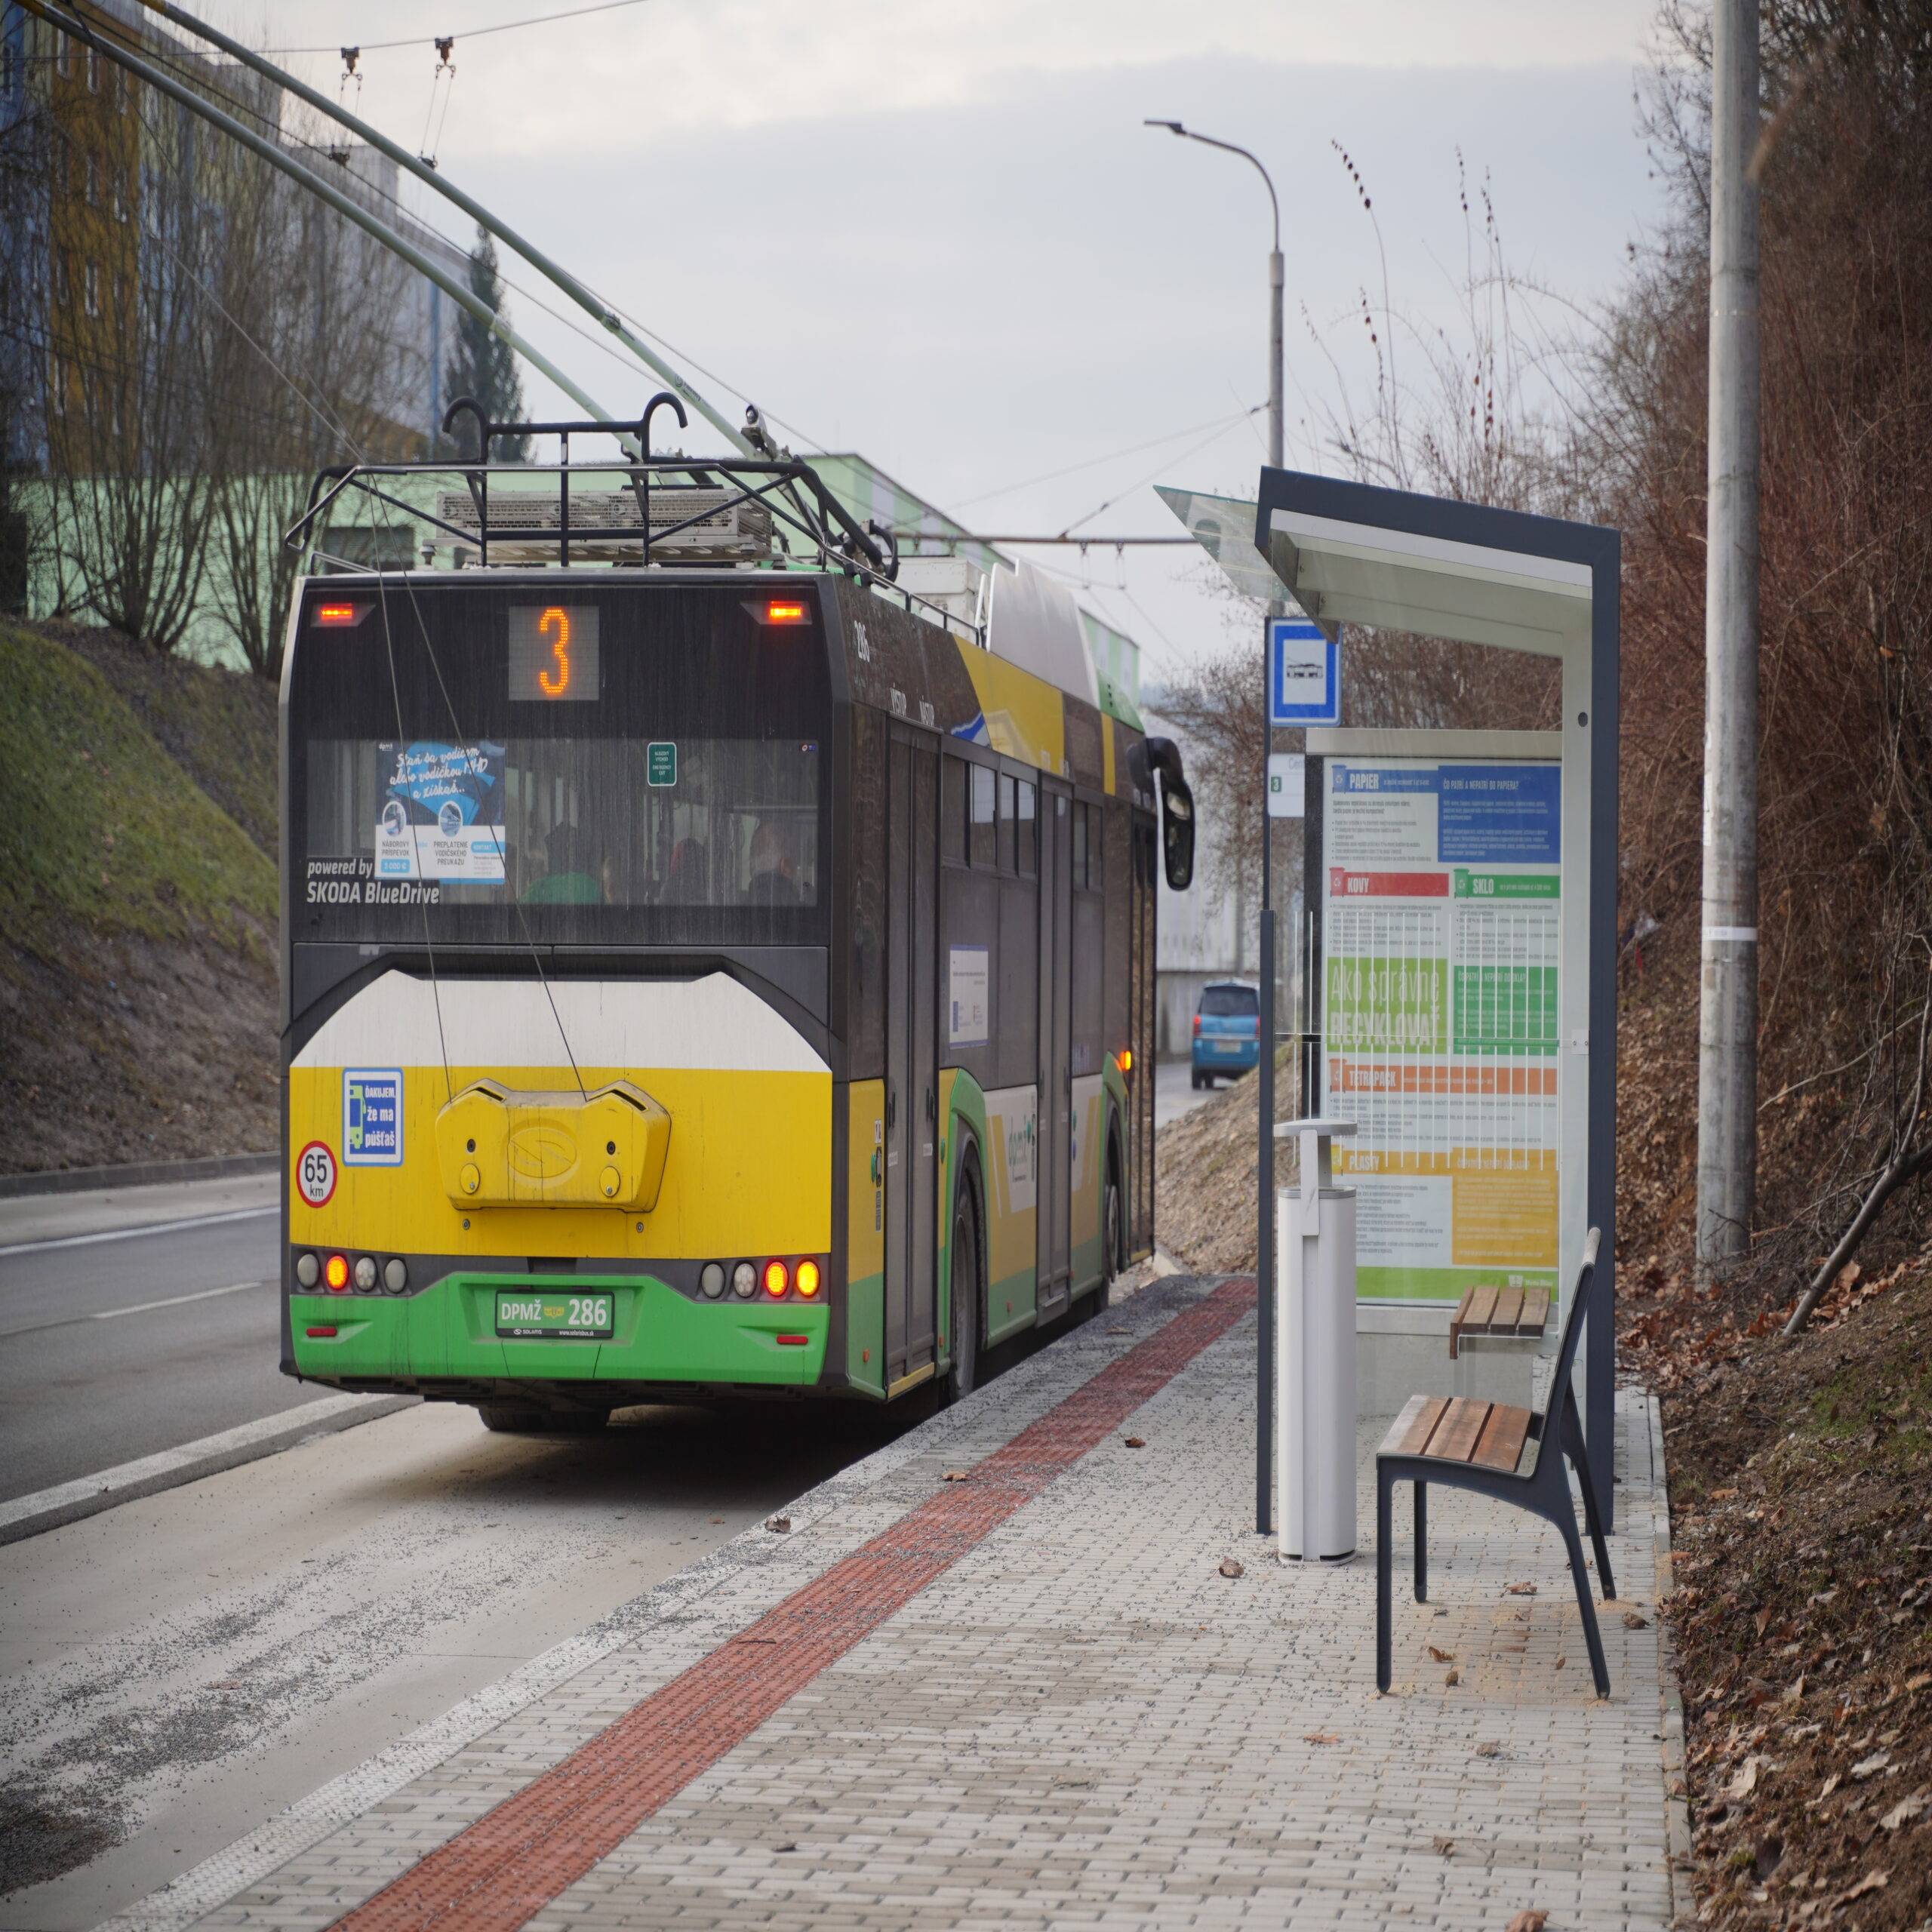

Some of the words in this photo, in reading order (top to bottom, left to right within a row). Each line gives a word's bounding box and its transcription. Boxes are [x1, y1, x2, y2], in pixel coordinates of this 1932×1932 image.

[854, 620, 870, 663] 286
[540, 608, 568, 694] 3
[424, 752, 438, 763] sa
[390, 768, 417, 785] alebo
[419, 762, 463, 782] vodičkou
[464, 757, 488, 774] MHD
[1273, 778, 1279, 791] 3
[1349, 773, 1380, 789] PAPIER
[307, 858, 356, 878] powered
[358, 858, 374, 878] by
[306, 881, 361, 903] SKODA
[365, 881, 439, 904] BlueDrive
[1347, 878, 1370, 895] KOVY
[1472, 878, 1494, 894] SKLO
[1331, 965, 1362, 1001] Ako
[1368, 965, 1439, 1006] správne
[1331, 1005, 1440, 1046] RECYKLOVAŤ
[1349, 1070, 1395, 1087] TETRAPACK
[367, 1106, 377, 1121] že
[380, 1109, 394, 1121] ma
[365, 1131, 395, 1148] púšťaš
[305, 1154, 327, 1183] 65
[1349, 1154, 1380, 1171] PLASTY
[310, 1184, 323, 1197] km
[501, 1299, 541, 1321] DPMŽ
[568, 1298, 607, 1326] 286
